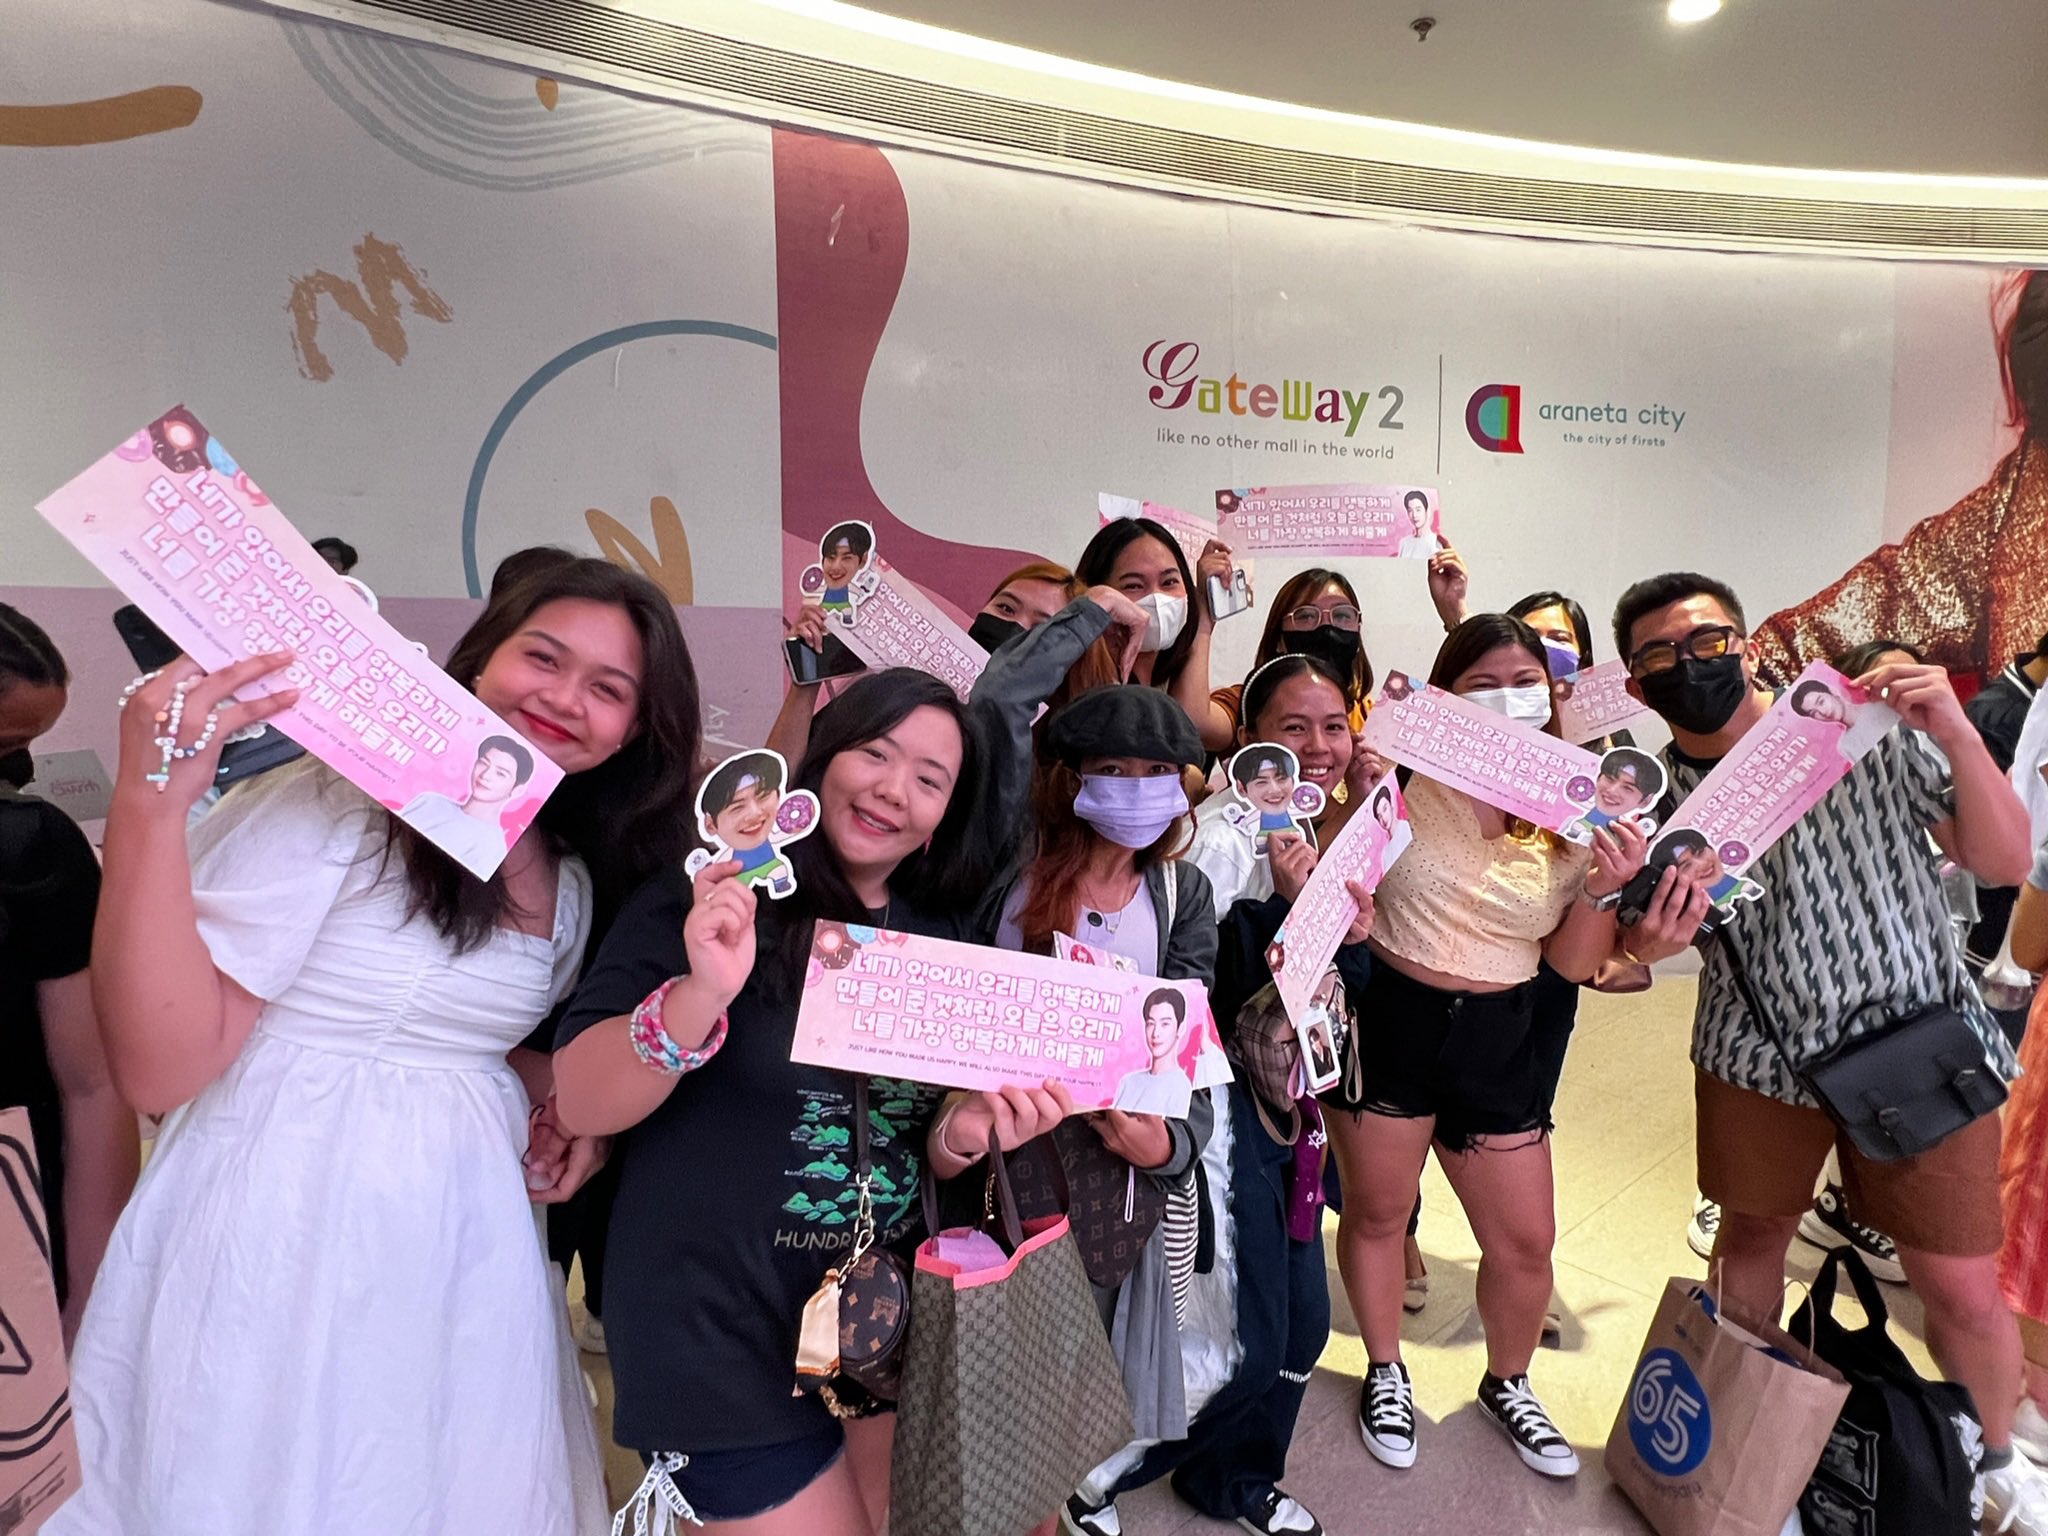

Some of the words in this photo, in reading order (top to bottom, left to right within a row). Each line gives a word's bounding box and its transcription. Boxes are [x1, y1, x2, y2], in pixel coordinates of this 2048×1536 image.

[1378, 385, 1404, 430] 2
[1539, 403, 1628, 423] araneta
[1638, 404, 1686, 433] city
[1157, 428, 1185, 444] like
[1191, 435, 1210, 446] no
[1216, 434, 1260, 450] other
[1264, 439, 1298, 453] mall
[1303, 440, 1317, 454] in
[1322, 442, 1347, 456] the
[1353, 446, 1394, 460] world
[1563, 433, 1583, 444] the
[1587, 434, 1611, 447] city
[1615, 434, 1628, 446] of
[1269, 498, 1305, 511] 있어서
[1309, 496, 1340, 509] 우리를
[1344, 496, 1390, 509] 행복하게
[1362, 511, 1394, 523] 우리가
[1272, 527, 1296, 540] 가장
[1299, 526, 1349, 539] 행복하게
[136, 473, 228, 560] 만들어
[209, 548, 253, 587] 준
[374, 696, 451, 759] 우리가
[181, 468, 249, 532] 네가
[229, 521, 314, 603] 있어서
[298, 592, 373, 663] 우리를
[358, 646, 462, 733] 행복하게
[907, 608, 943, 648] 우리를
[136, 520, 203, 583] 너를
[184, 568, 251, 633] 가장
[230, 616, 344, 713] 행하게
[333, 698, 417, 770] 해줄게
[1390, 704, 1433, 734] 만들어
[1533, 766, 1567, 792] 우리
[1405, 693, 1437, 715] 네가
[1435, 705, 1481, 734] 있어서
[1479, 724, 1520, 753] 우리를
[1518, 741, 1580, 777] 행복하게
[1766, 733, 1810, 773] 우리가
[1396, 725, 1424, 749] 너를
[1423, 737, 1454, 763] 가장
[1452, 749, 1513, 789] 행복하게
[1511, 775, 1558, 808] 해줄게
[1702, 775, 1745, 812] 우리를
[1733, 725, 1790, 781] 행복하게
[833, 975, 903, 1012] 만들어
[903, 986, 927, 1016] 준
[927, 990, 1001, 1028] 것처럼,
[1001, 1002, 1066, 1038] 오늘은,
[1066, 1014, 1123, 1046] 우리가
[851, 950, 903, 979] 네가
[902, 958, 974, 994] 있어서
[974, 969, 1037, 1005] 우리를
[1037, 979, 1122, 1019] 행복하게
[847, 1043, 862, 1051] JUST
[894, 1050, 907, 1058] YOU
[850, 1007, 896, 1040] 너를
[896, 1015, 947, 1049] 가장
[947, 1022, 1042, 1063] 행복하게
[1041, 1037, 1105, 1072] 해줄게
[773, 1227, 856, 1251] HUNDR
[1633, 1358, 1701, 1464] 65
